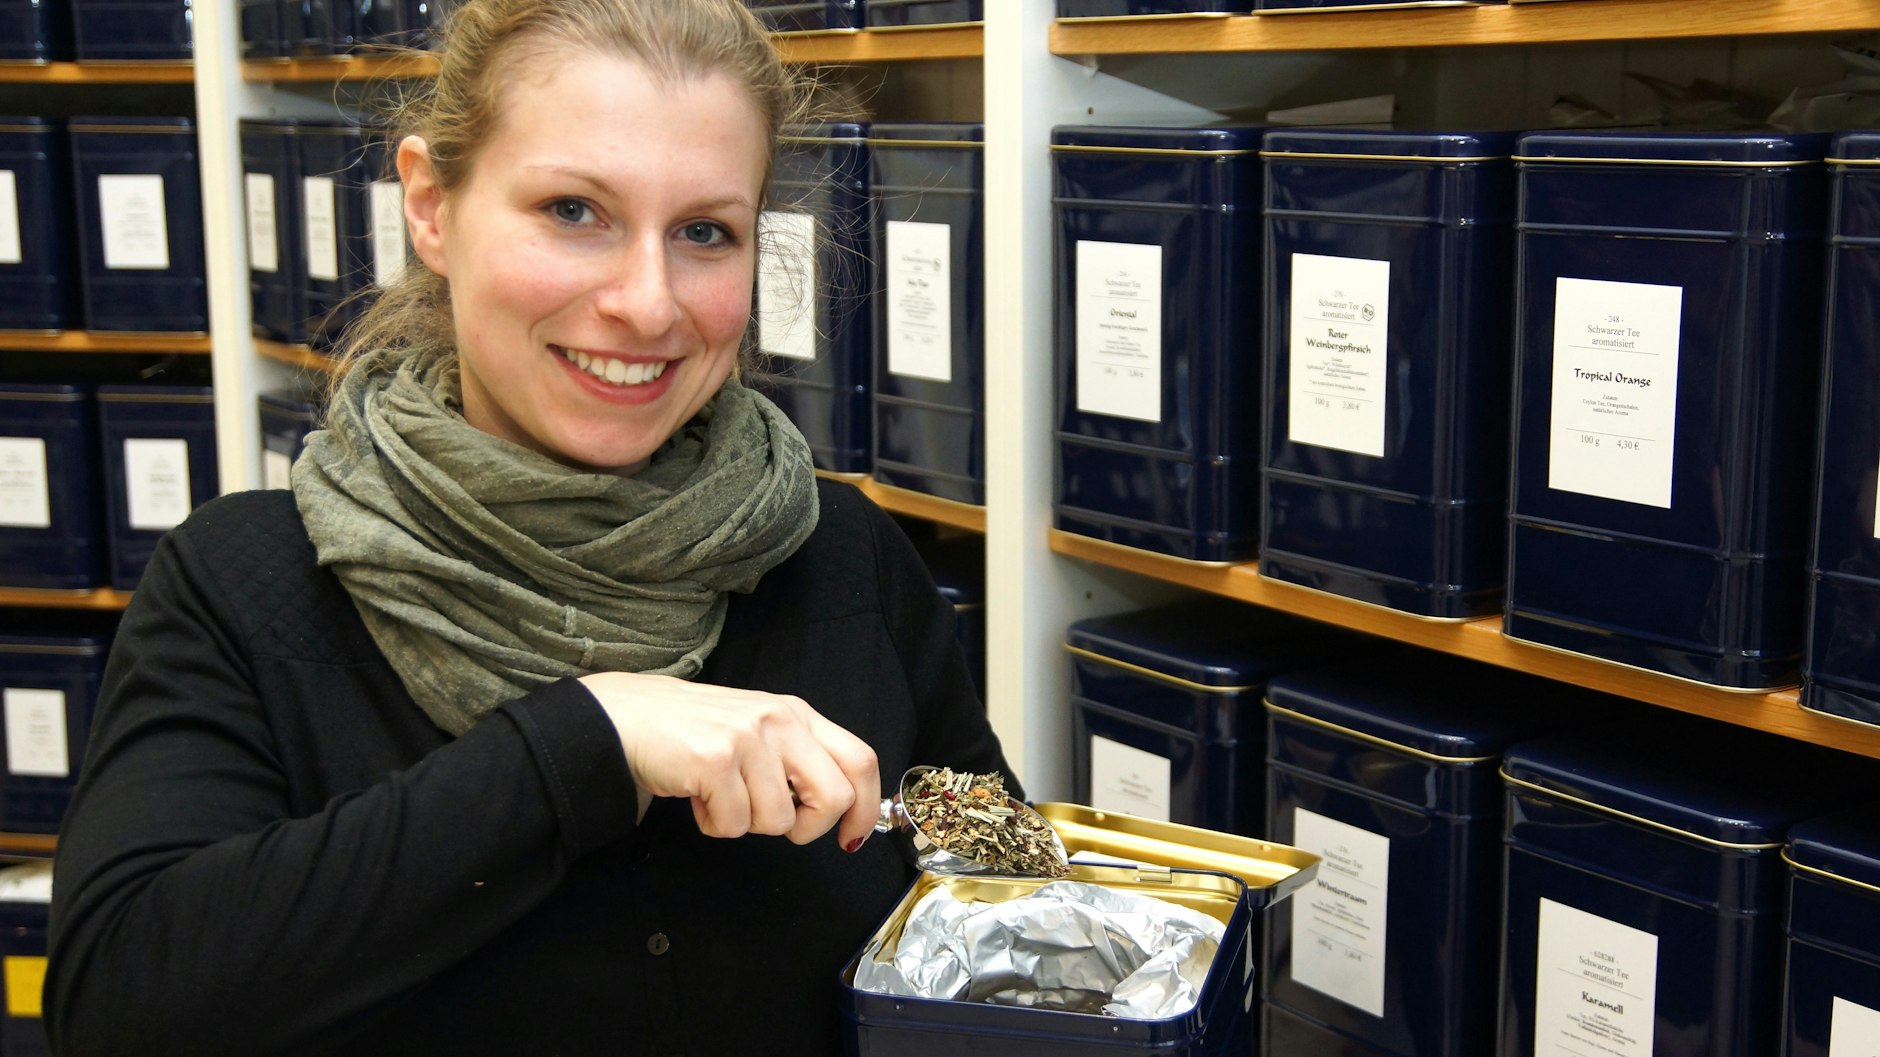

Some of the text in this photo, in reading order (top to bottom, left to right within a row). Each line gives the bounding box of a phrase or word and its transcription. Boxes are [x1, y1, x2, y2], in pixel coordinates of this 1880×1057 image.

[1318, 298, 1347, 309] Schwarzer
[1608, 315, 1620, 323] 248
[1328, 328, 1348, 339] Roter
[1587, 324, 1641, 338] Schwarzer Tee
[1306, 337, 1371, 354] Weinbergpfirsich
[1591, 338, 1635, 349] aromatisiert
[1574, 368, 1651, 388] Tropical Orange
[1581, 434, 1640, 451] 100 g 4,30 €
[1316, 877, 1368, 906] Wintertraum
[1579, 955, 1629, 980] Schwarzer Tee
[1583, 969, 1623, 989] aromatisiert
[1582, 991, 1623, 1015] Karamell
